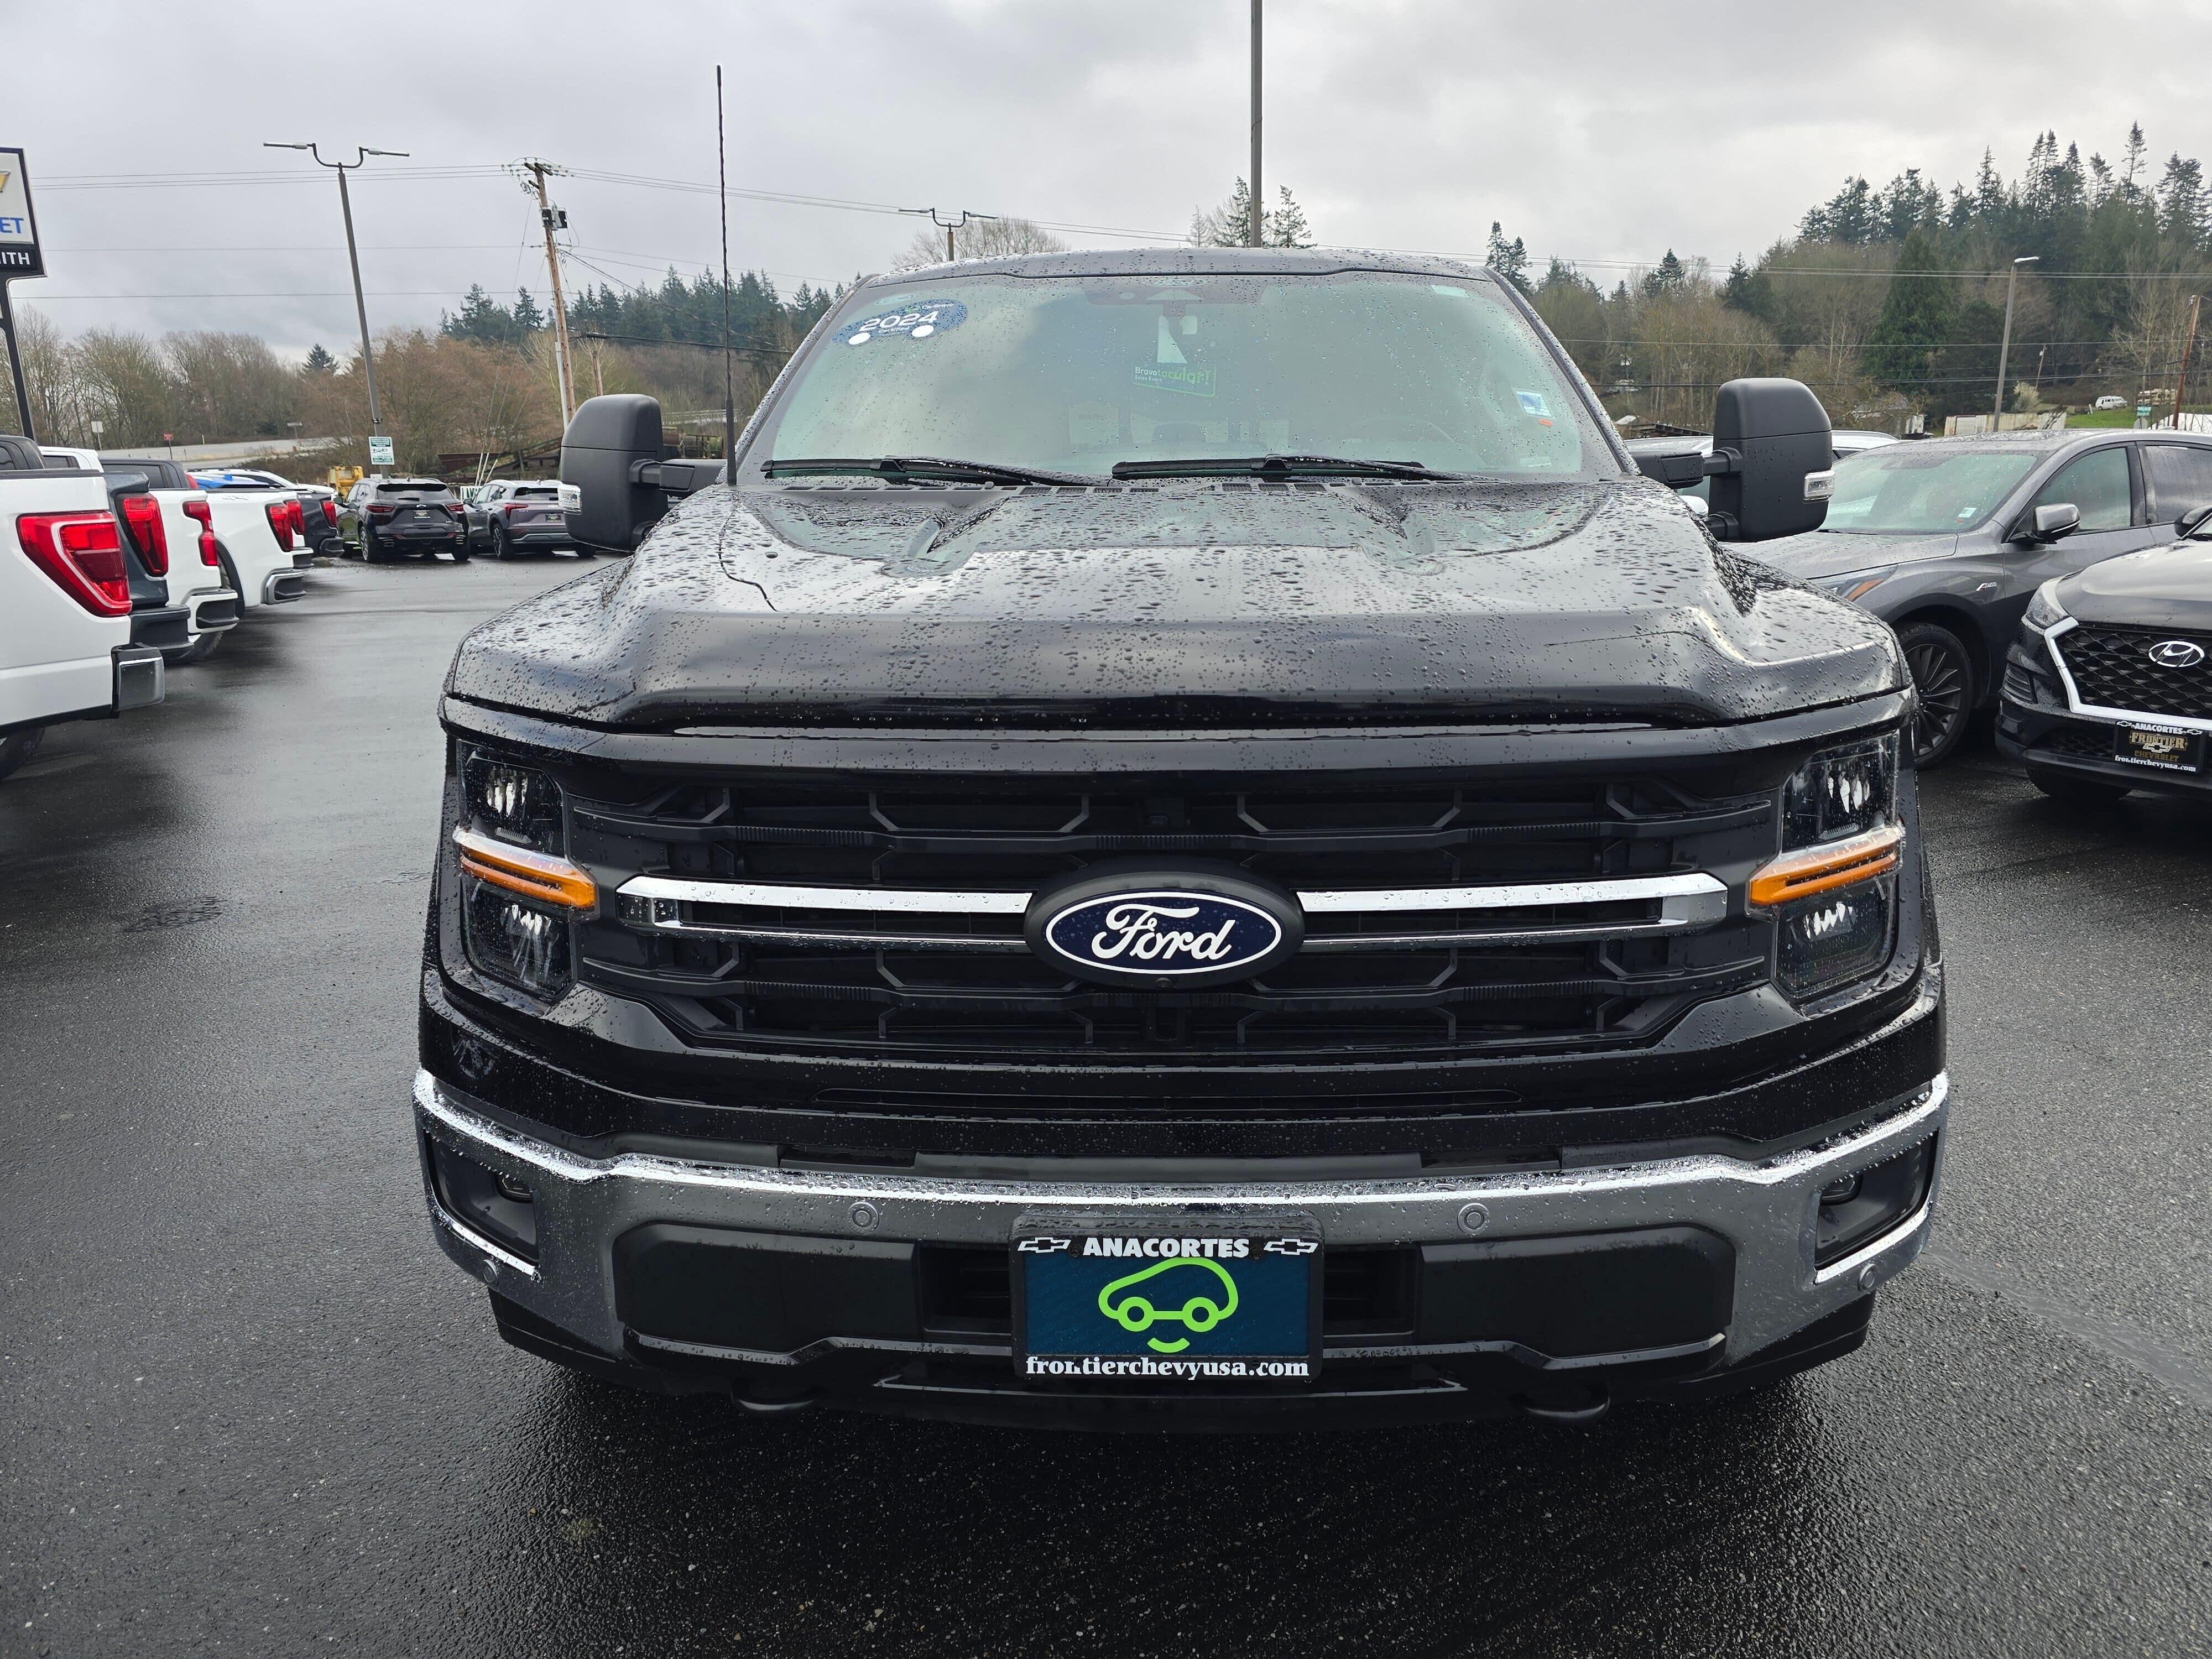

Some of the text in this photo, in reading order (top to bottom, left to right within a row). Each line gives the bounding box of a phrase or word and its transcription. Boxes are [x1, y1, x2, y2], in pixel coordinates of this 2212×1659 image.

[0, 252, 30, 265] ITH
[859, 311, 939, 332] 2024
[2134, 722, 2184, 734] ANACORTES
[1092, 904, 1236, 959] Ford
[1082, 1237, 1250, 1258] ANACORTES
[1026, 1356, 1310, 1380] frontierchevyusa.com
